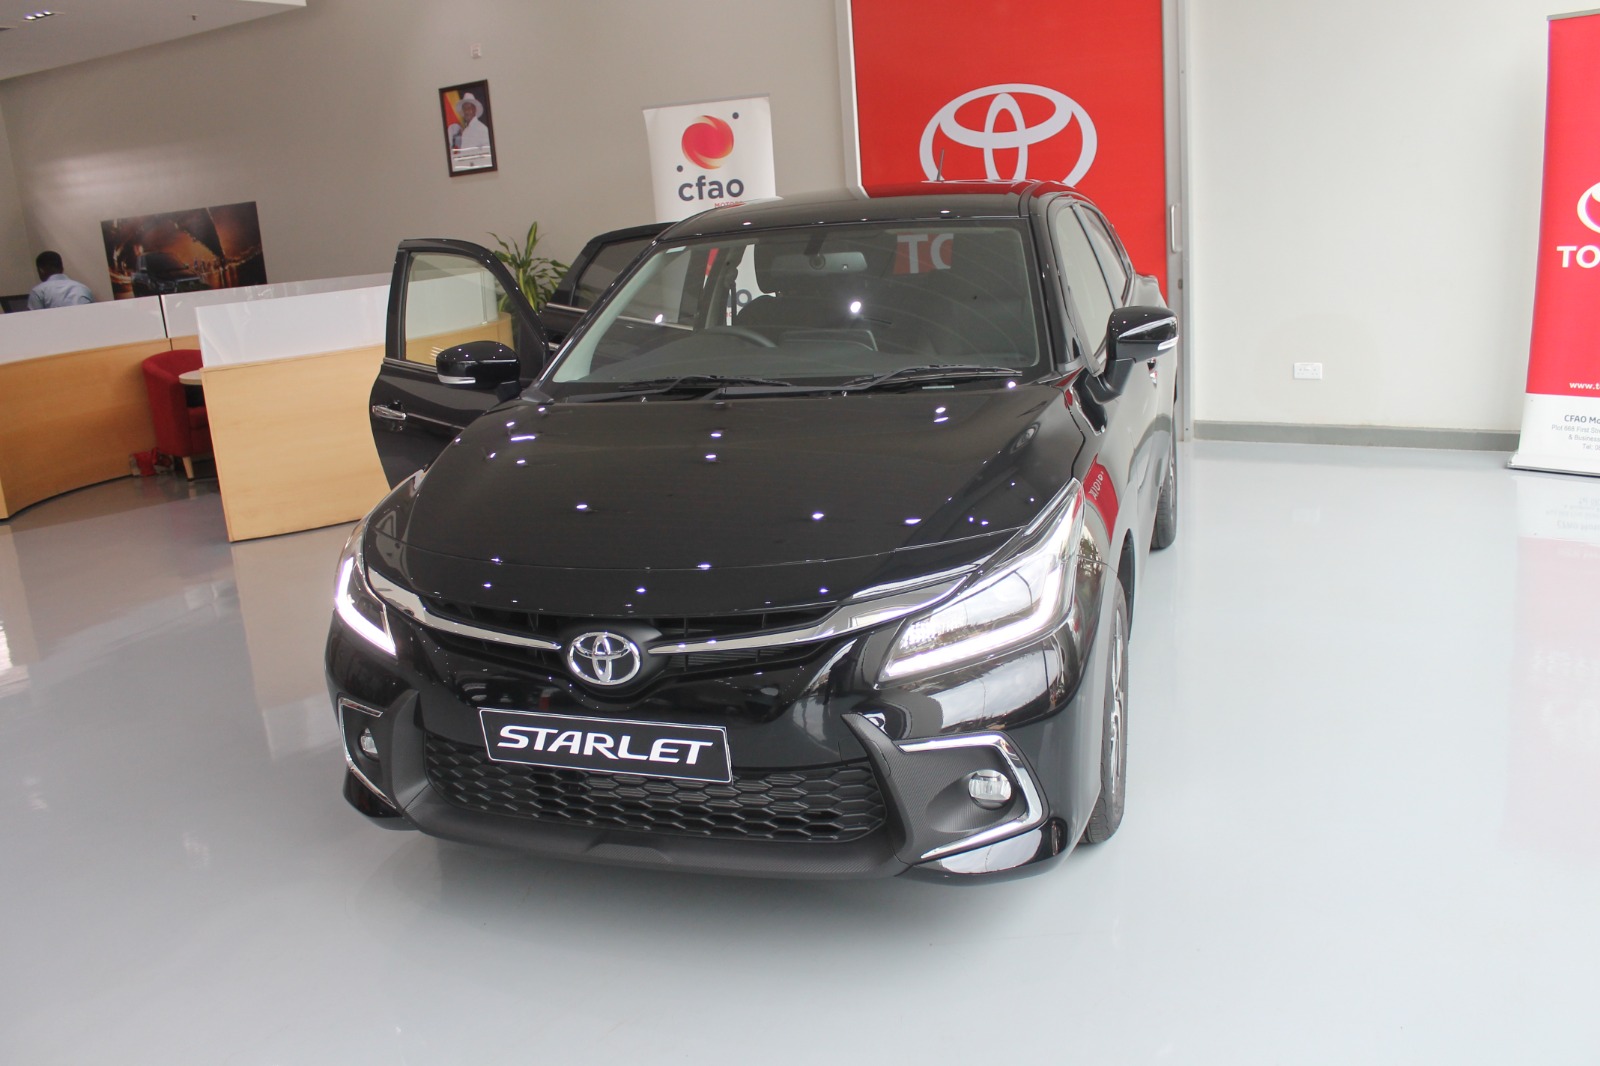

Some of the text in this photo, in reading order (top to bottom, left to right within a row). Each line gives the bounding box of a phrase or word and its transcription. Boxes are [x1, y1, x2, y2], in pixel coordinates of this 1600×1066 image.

[678, 175, 744, 201] cfao
[1569, 382, 1600, 390] www.t
[1564, 414, 1587, 423] CFAO
[497, 725, 713, 765] STARLET
